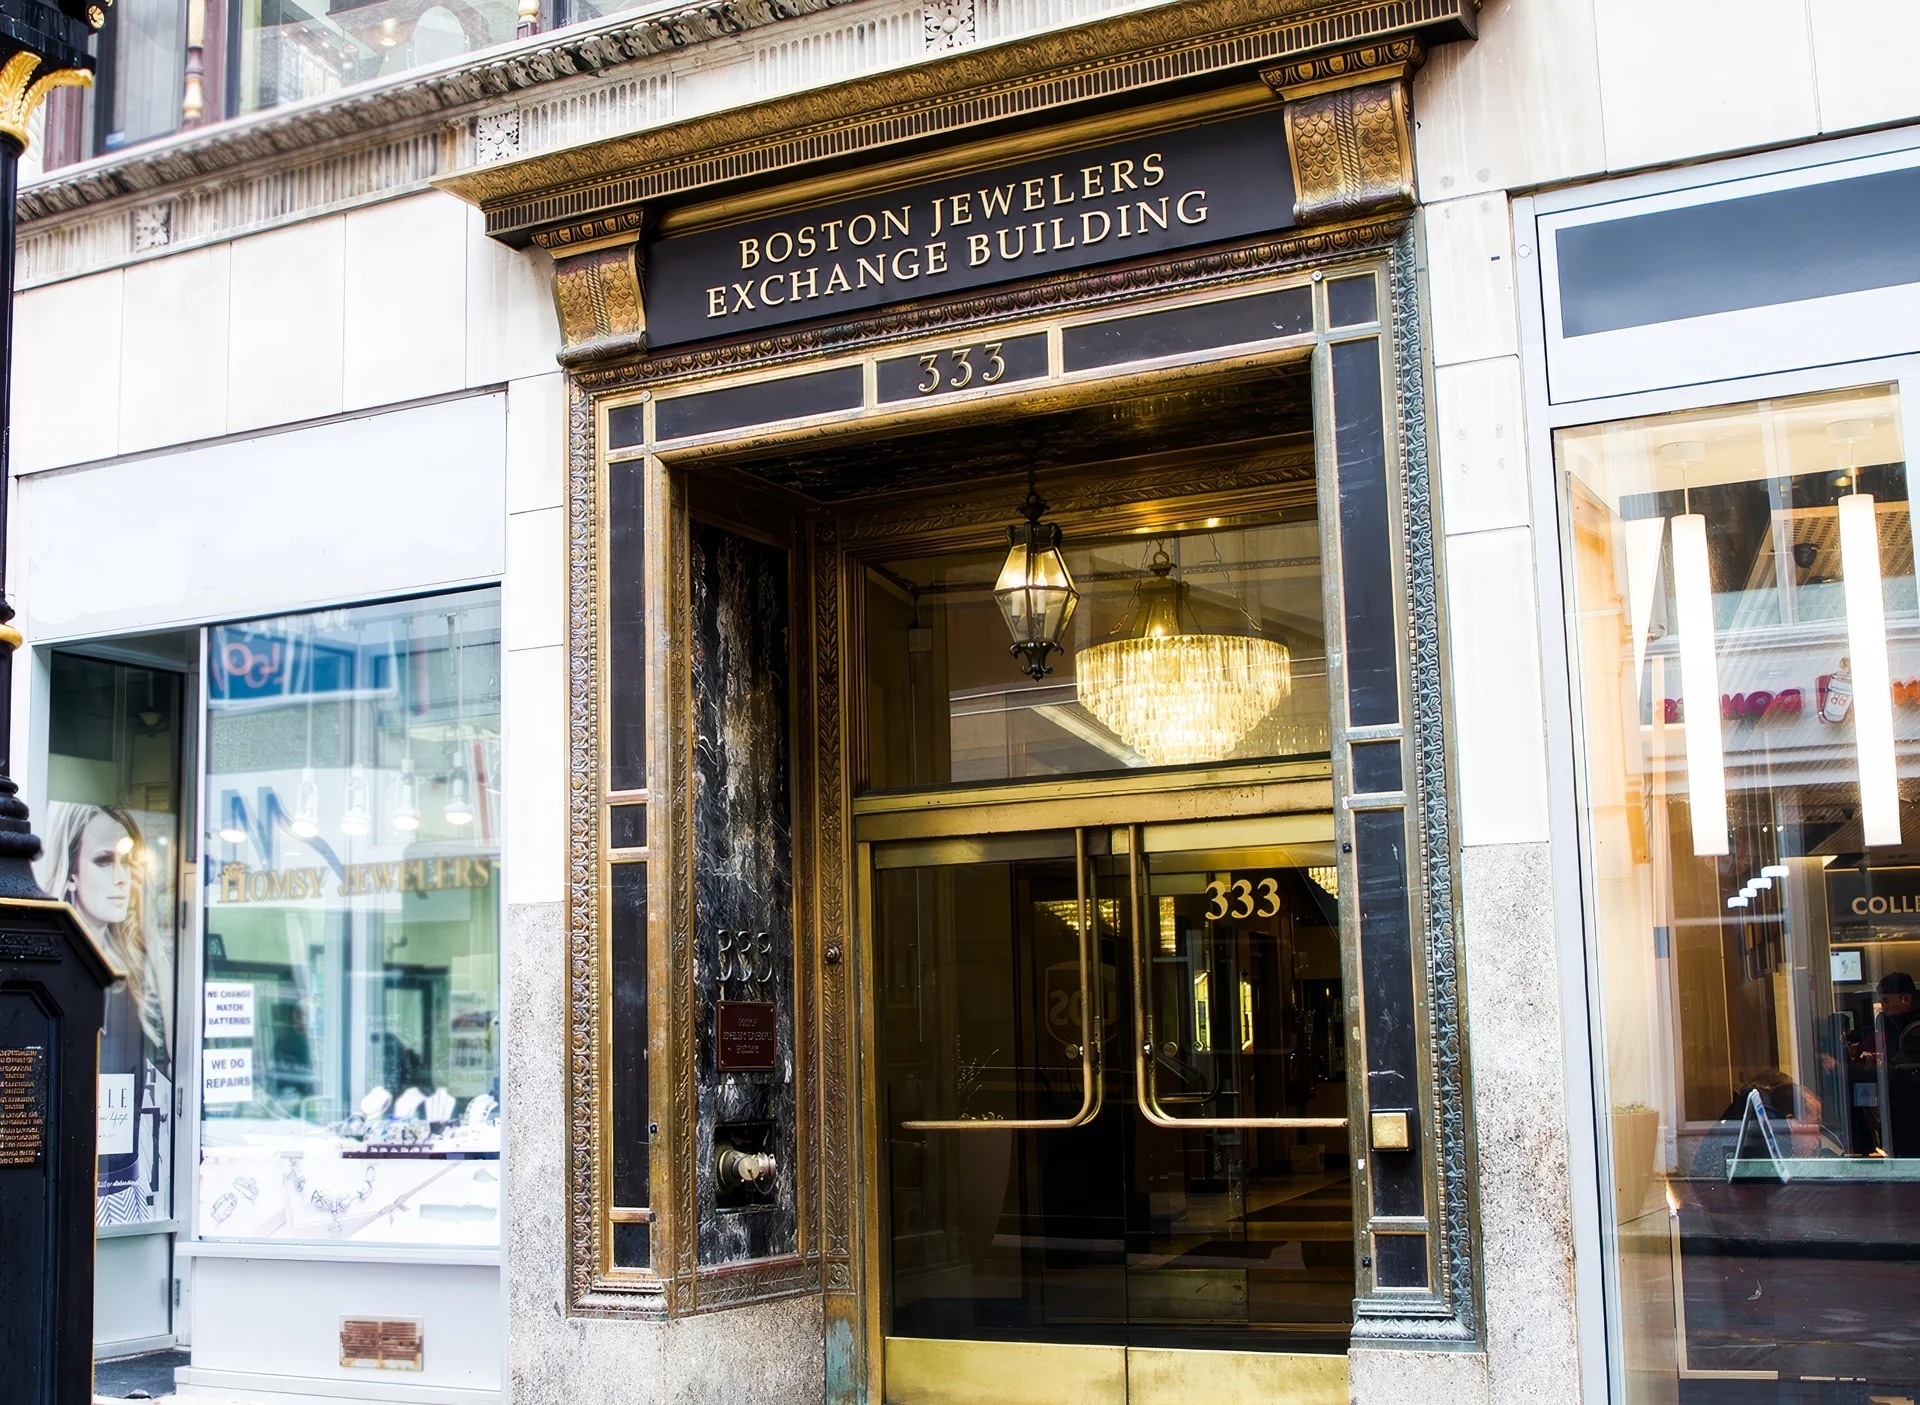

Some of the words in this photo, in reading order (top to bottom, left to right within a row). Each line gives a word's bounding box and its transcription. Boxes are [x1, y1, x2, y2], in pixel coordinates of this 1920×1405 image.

[738, 204, 912, 270] BOSTON
[931, 152, 1166, 237] JEWELERS
[706, 241, 948, 318] EXCHANGE
[968, 189, 1209, 267] BUILDING
[918, 342, 1007, 394] 333
[216, 861, 328, 904] HOMSY
[337, 855, 492, 897] JEWELERS
[1204, 877, 1281, 921] 333
[715, 929, 773, 983] 333
[208, 1017, 251, 1025] BATTERIES
[206, 1076, 251, 1089] REPAIRS
[211, 1059, 227, 1070] WE
[230, 1058, 245, 1069] DO
